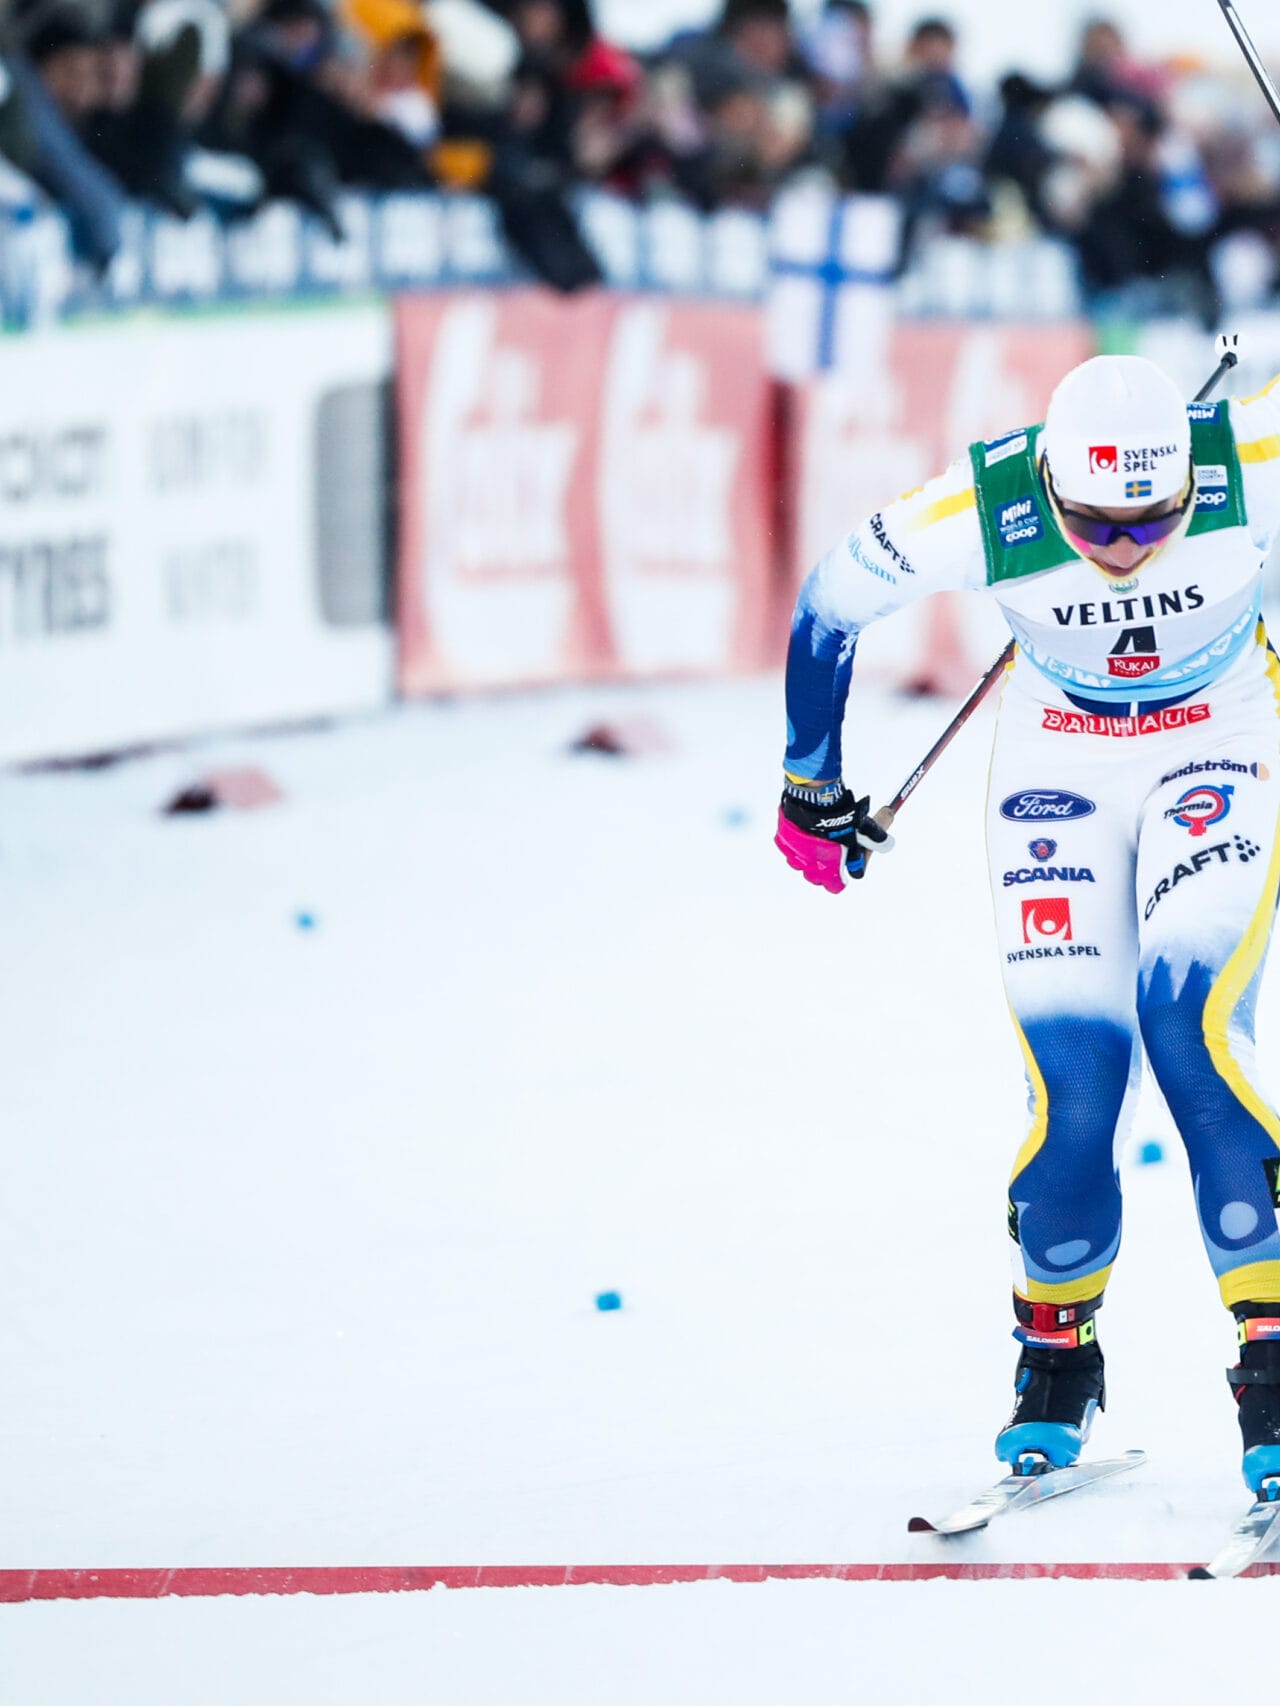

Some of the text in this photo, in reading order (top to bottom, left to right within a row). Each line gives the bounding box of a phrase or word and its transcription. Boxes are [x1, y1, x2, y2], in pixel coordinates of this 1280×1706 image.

[1124, 444, 1177, 460] SVENSKA
[1124, 460, 1157, 472] SPEL
[869, 512, 901, 561] CRAFT
[1005, 525, 1037, 544] coop
[1052, 584, 1205, 626] VELTINS
[1109, 625, 1157, 655] 4
[1045, 704, 1208, 736] BAUHAUS
[1014, 794, 1074, 817] Ford
[1164, 800, 1213, 819] Thermia
[1003, 867, 1095, 886] SCANIA
[1145, 842, 1231, 921] CRAFT
[1007, 945, 1101, 963] SVENSKA SPEL
[1026, 1335, 1070, 1344] SALOMON
